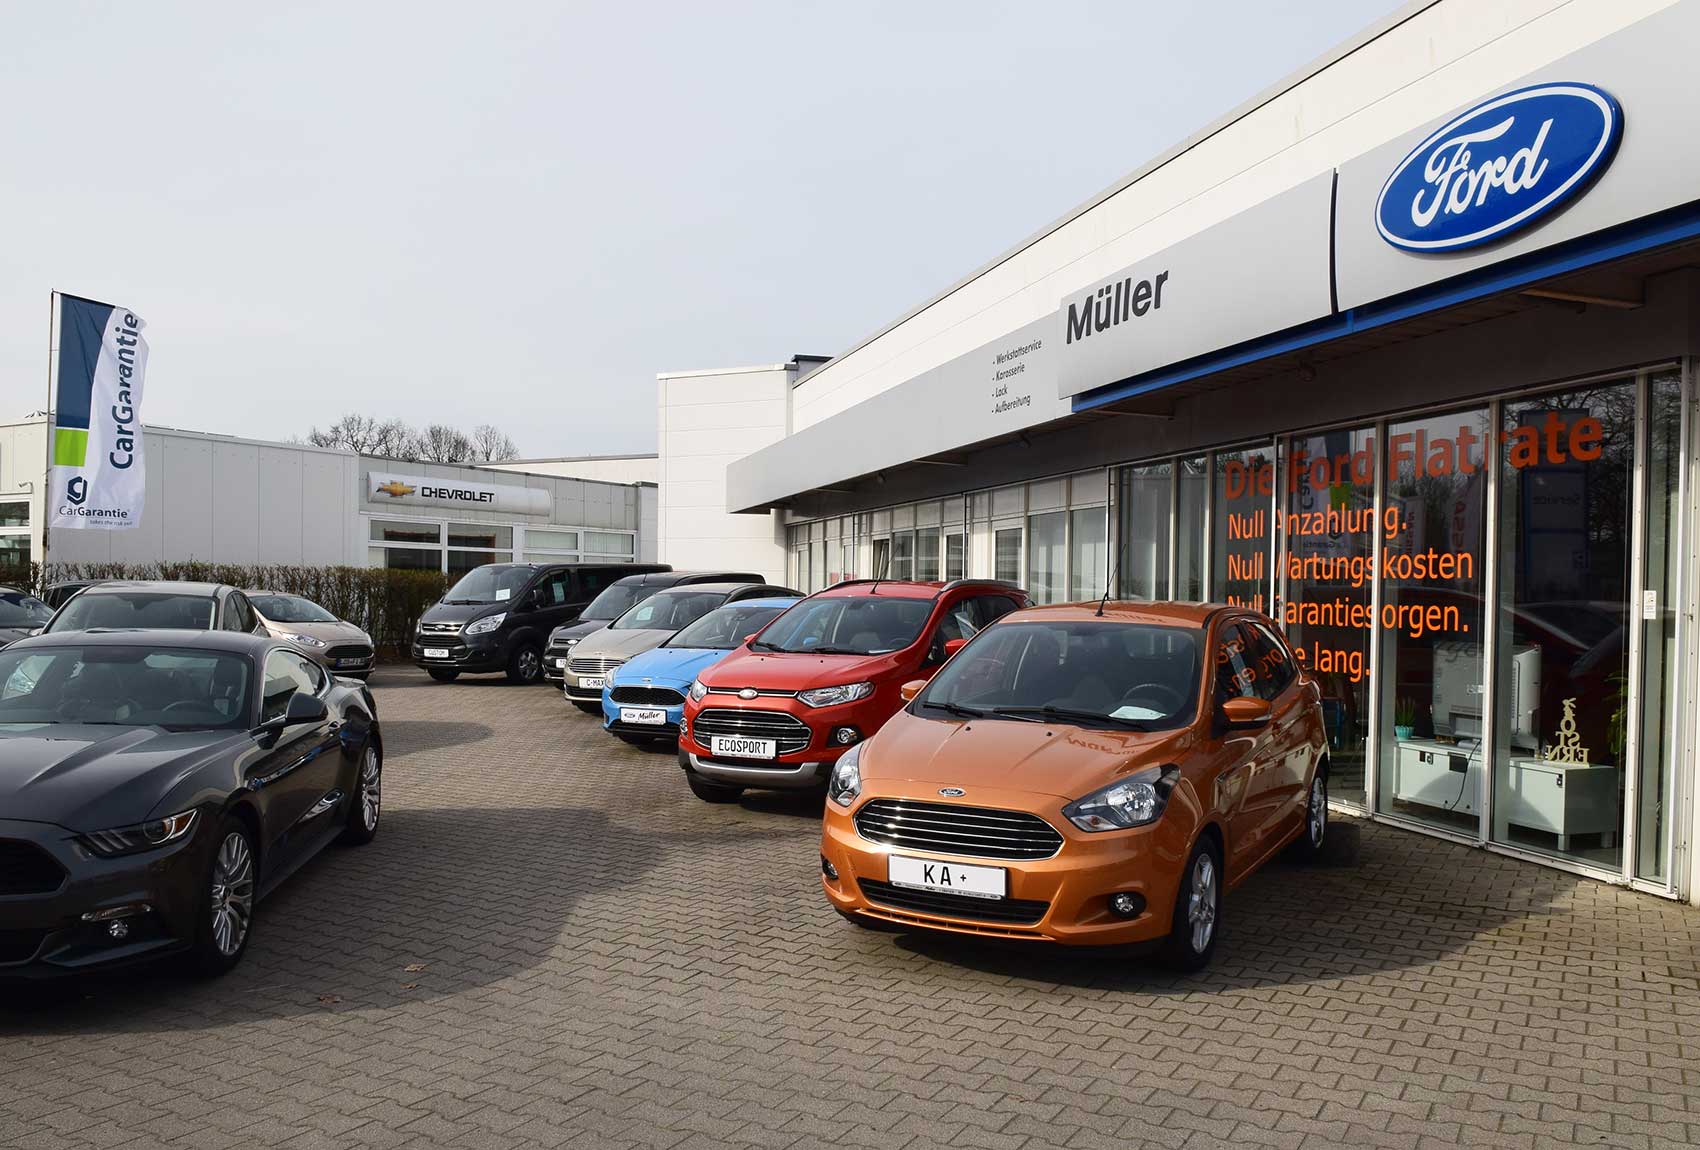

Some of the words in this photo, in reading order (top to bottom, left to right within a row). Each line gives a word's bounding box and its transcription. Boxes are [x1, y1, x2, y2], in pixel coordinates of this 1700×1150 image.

[1411, 115, 1554, 227] Ford
[1066, 270, 1169, 345] Müller
[996, 339, 1042, 365] Werkstattservice
[995, 362, 1025, 381] Karosserie
[109, 313, 138, 470] CarGarantie
[994, 394, 1031, 414] Aufbereitung
[995, 384, 1008, 398] Lack
[1225, 456, 1273, 499] Die
[1286, 437, 1374, 492] Ford
[421, 486, 495, 502] CHEVROLET
[59, 505, 128, 518] CarGarantie
[1228, 510, 1264, 540] Null
[1228, 552, 1264, 581] Null
[1314, 641, 1371, 683] lang.
[718, 738, 768, 754] ECOSPORT
